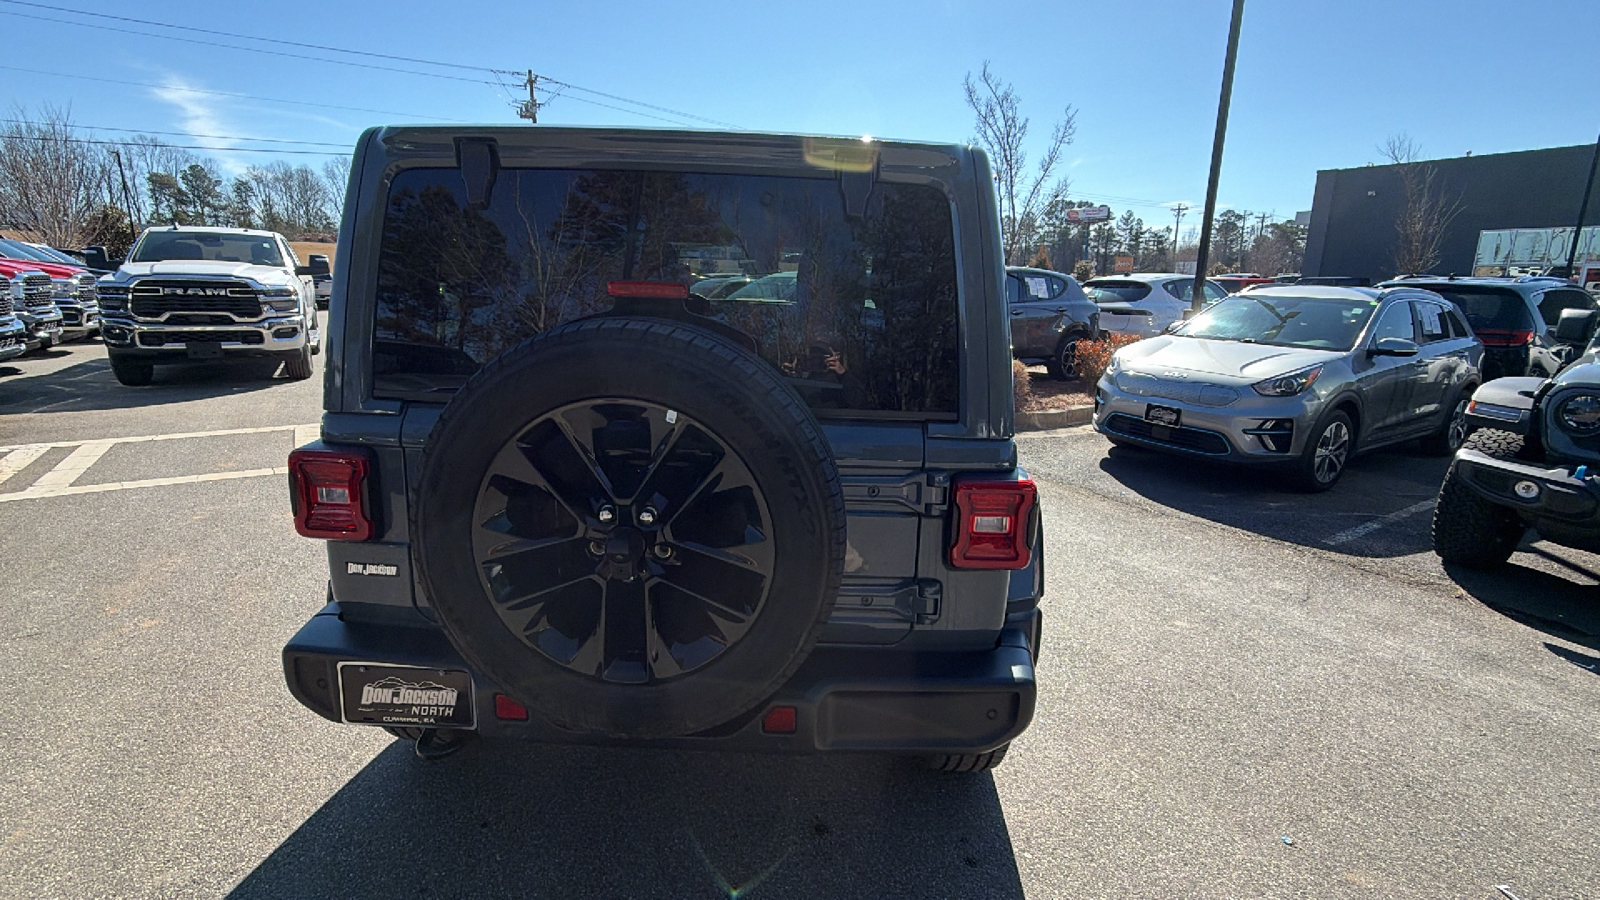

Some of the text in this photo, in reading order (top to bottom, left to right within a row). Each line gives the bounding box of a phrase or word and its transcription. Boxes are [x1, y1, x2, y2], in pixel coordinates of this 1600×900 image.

[164, 287, 226, 296] RAM
[348, 562, 397, 576] DON JACKSON
[361, 686, 458, 706] DON JACKSON
[411, 706, 454, 717] NORTH
